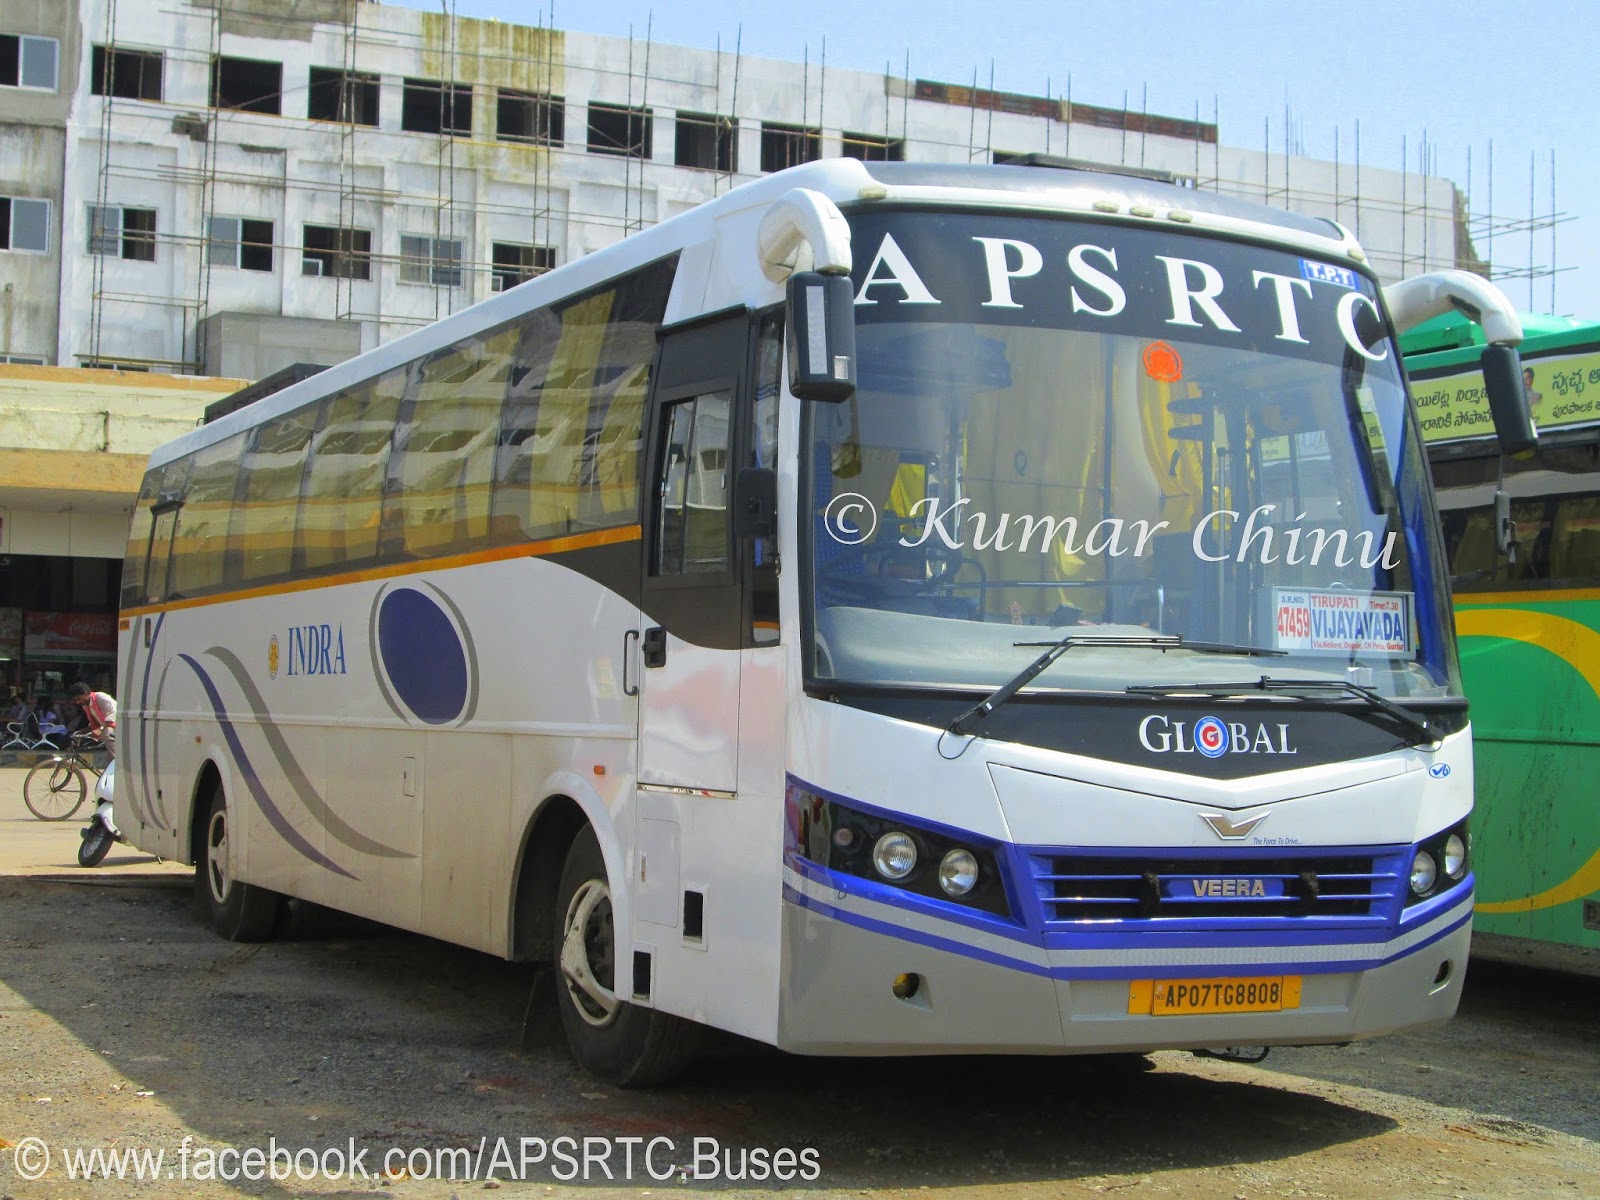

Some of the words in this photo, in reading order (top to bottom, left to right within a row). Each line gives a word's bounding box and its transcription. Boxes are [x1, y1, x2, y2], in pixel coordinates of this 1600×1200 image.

[855, 232, 1388, 361] APSRTC
[1312, 596, 1358, 608] TIRUPATI
[1278, 607, 1310, 638] 47459
[1312, 609, 1403, 641] VIJAYAVADA
[287, 623, 346, 675] INDRA
[1254, 837, 1263, 845] The
[1263, 837, 1277, 845] Force
[1278, 837, 1285, 845] To
[1192, 879, 1265, 897] VEERA
[1165, 982, 1279, 1008] AP07TG8808
